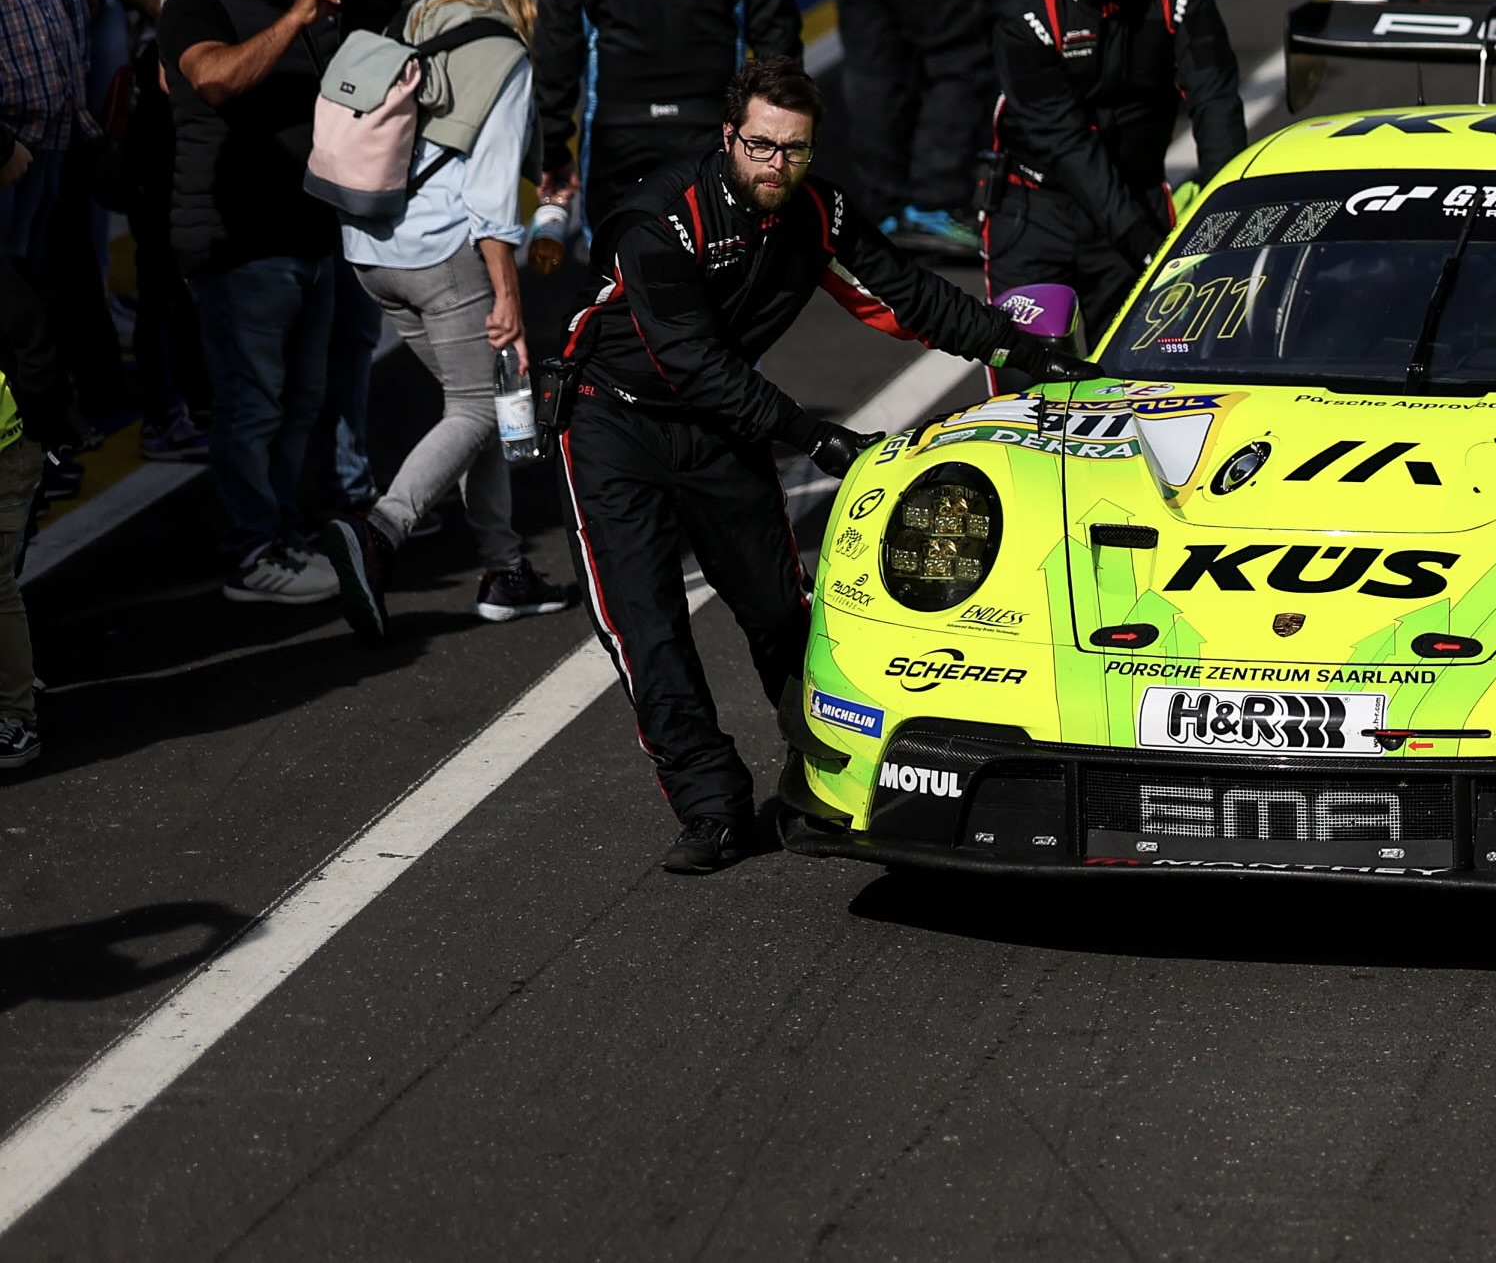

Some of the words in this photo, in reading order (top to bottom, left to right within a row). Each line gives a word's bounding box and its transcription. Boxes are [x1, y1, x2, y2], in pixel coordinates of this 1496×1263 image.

[831, 189, 845, 236] HRX
[668, 214, 695, 254] HRX
[1130, 275, 1267, 351] 911
[1294, 394, 1388, 407] Porsche
[1042, 413, 1134, 437] 911
[989, 429, 1134, 457] DEKRA
[1162, 543, 1461, 599] KÜS
[830, 580, 875, 606] PADDOCK
[960, 604, 1030, 625] ENDLESS
[885, 656, 1027, 685] SCHERER
[1104, 661, 1203, 679] PORSCHE
[1206, 666, 1310, 682] ZENTRUM
[1316, 669, 1436, 685] SAARLAND
[821, 703, 876, 728] MICHELIN
[1168, 692, 1283, 747] H&R
[879, 762, 962, 798] MOTUL
